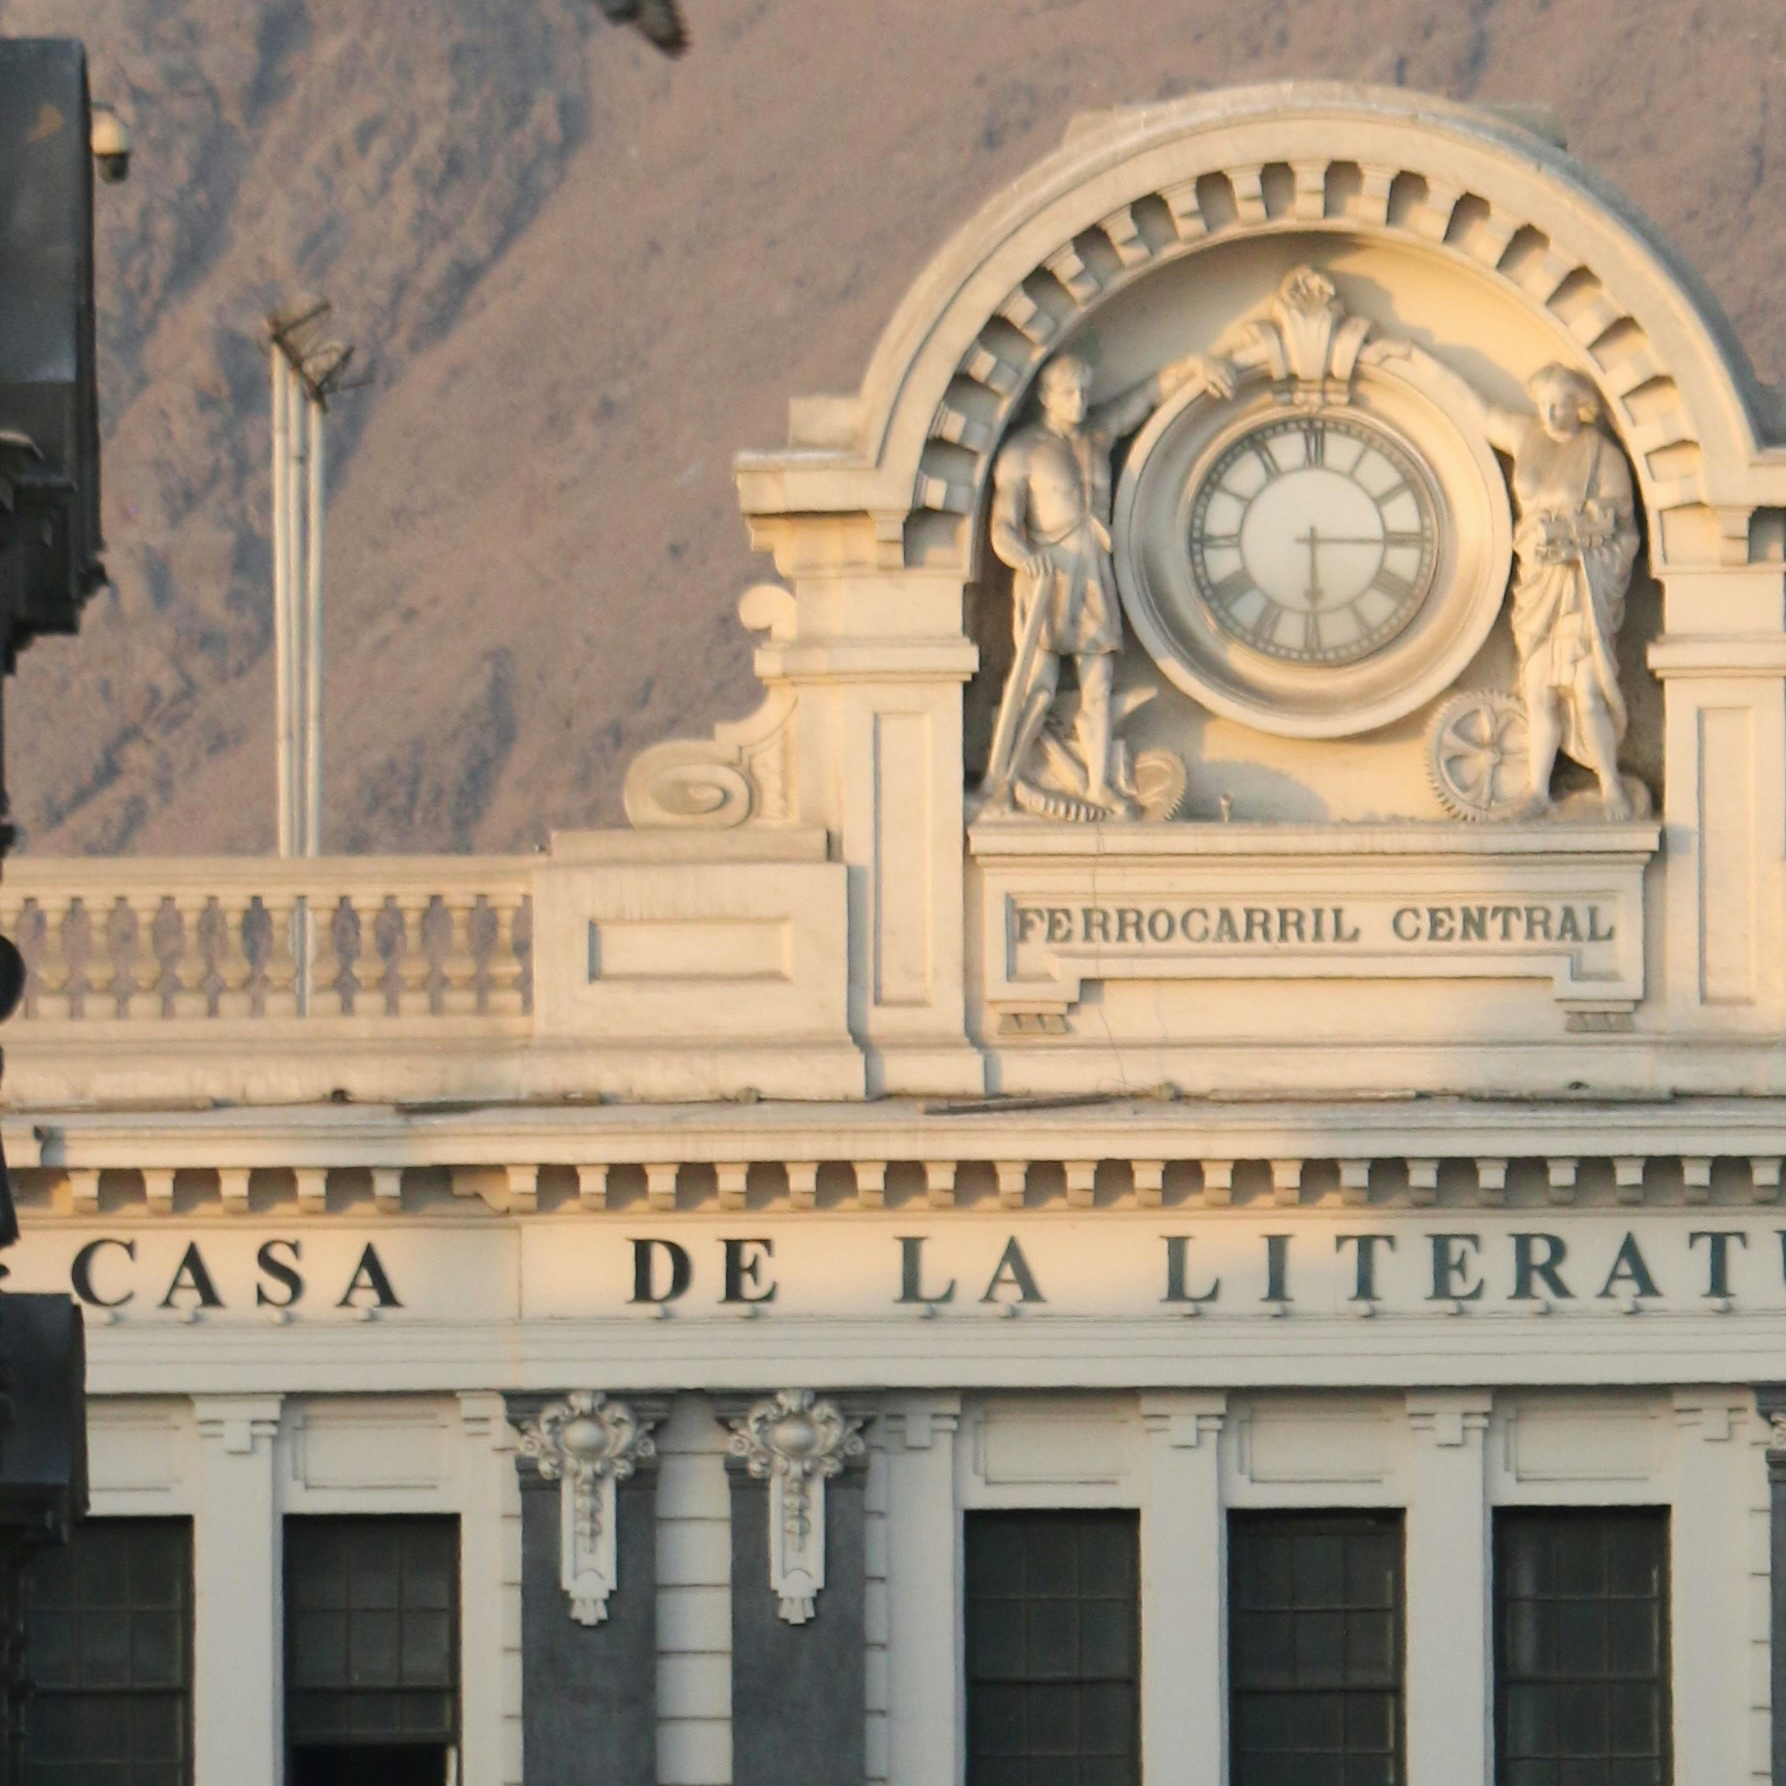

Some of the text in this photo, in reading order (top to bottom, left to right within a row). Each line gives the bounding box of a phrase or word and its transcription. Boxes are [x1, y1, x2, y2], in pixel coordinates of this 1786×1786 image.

[1012, 904, 1616, 944] FERROCARRIL CENTRAL
[70, 1237, 406, 1309] CASA
[629, 1237, 778, 1305] DE
[894, 1234, 1047, 1305] LA
